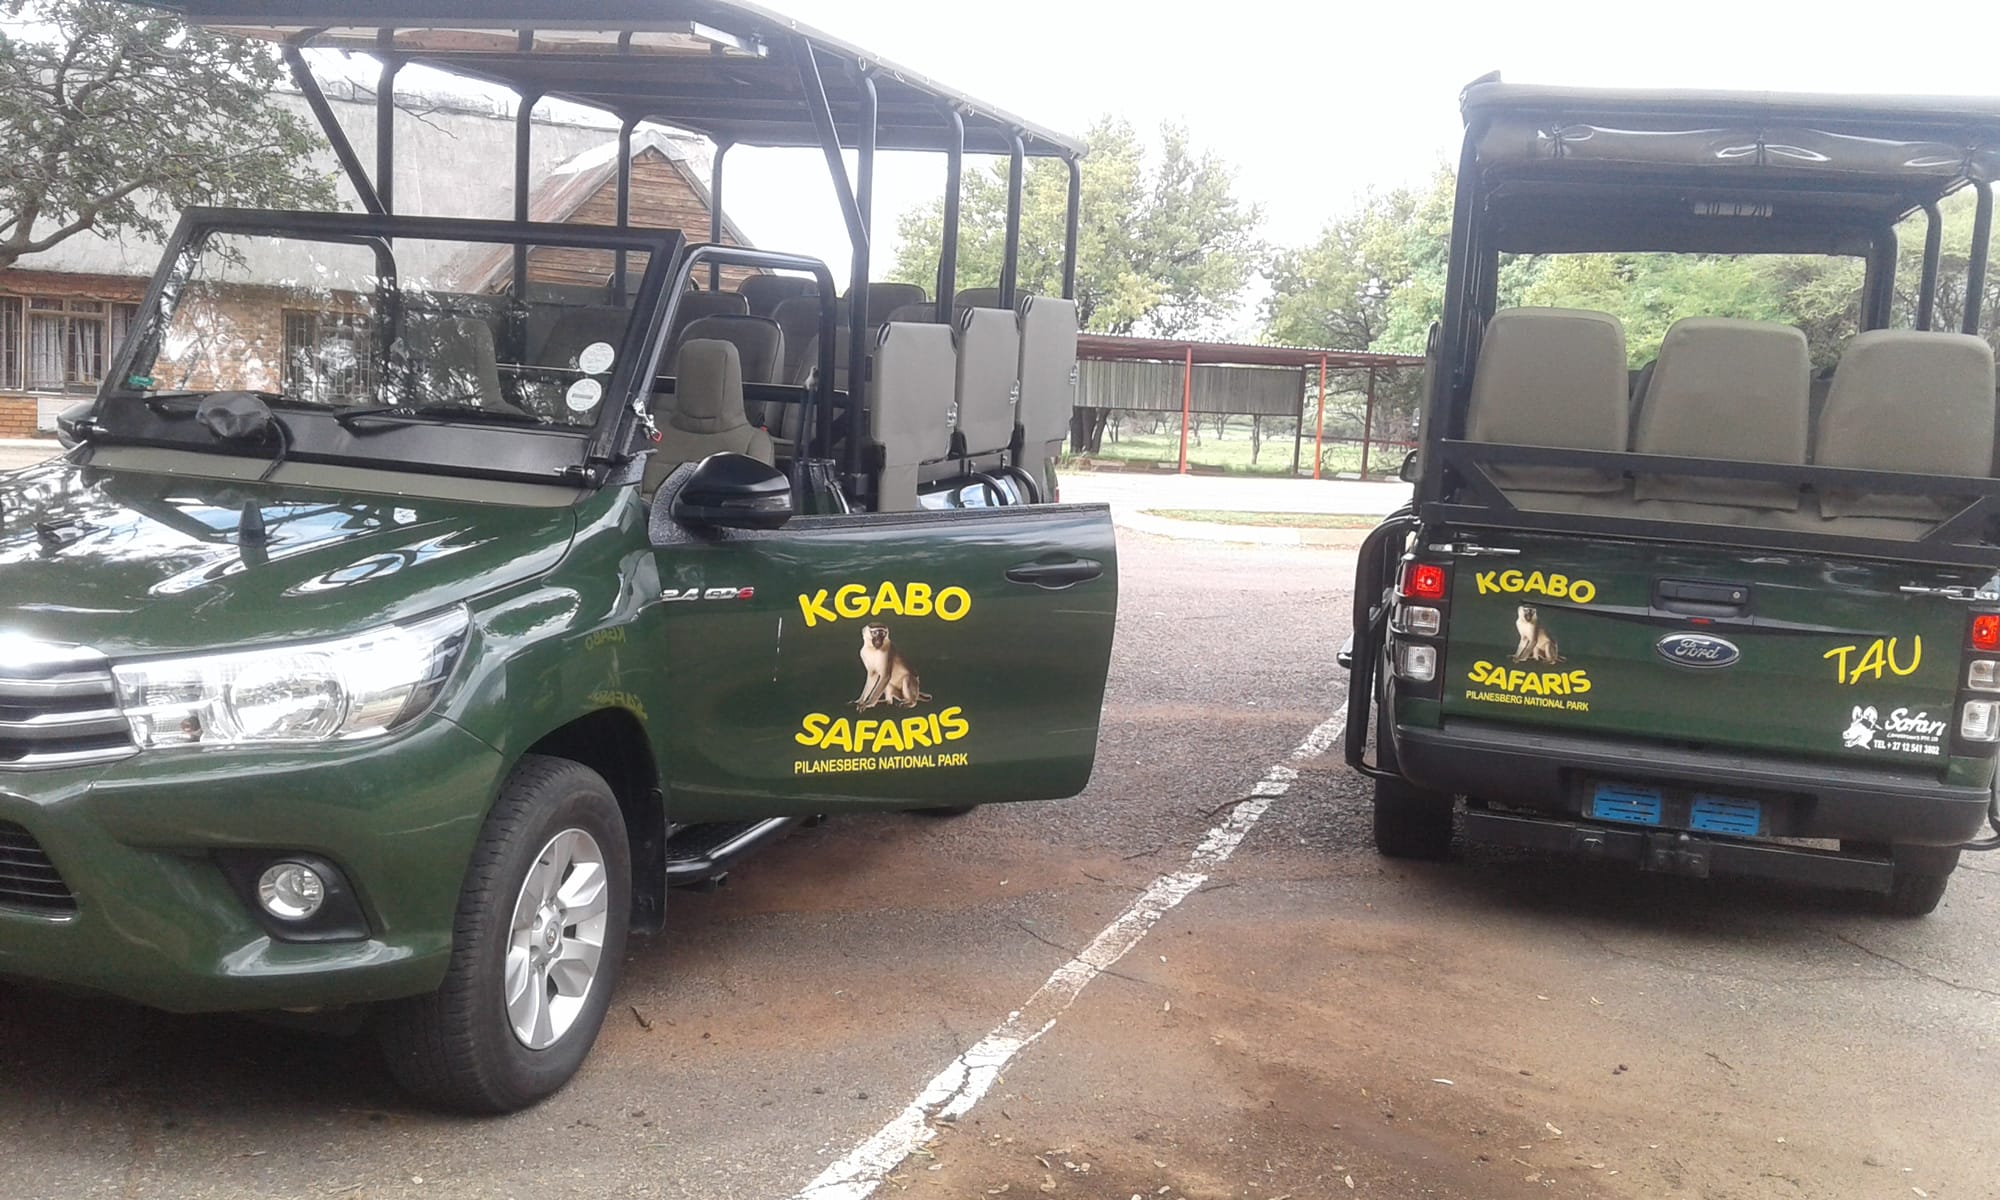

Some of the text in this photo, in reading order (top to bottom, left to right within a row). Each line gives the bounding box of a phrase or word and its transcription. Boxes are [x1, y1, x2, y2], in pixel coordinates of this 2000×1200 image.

[1475, 569, 1596, 603] KGABO
[798, 581, 971, 627] KGABO
[1674, 638, 1721, 660] Ford
[1823, 634, 1921, 684] TAU
[1467, 660, 1592, 695] SAFARIS
[1466, 690, 1589, 712] PILANESBERG NATIONAL PARK
[794, 706, 969, 753] SAFARIS
[1885, 708, 1946, 736] Safari
[1874, 740, 1886, 749] TEL
[1892, 741, 1901, 751] 27
[1902, 742, 1910, 752] 12
[794, 753, 968, 774] PILANESBERG NATIONAL PARK
